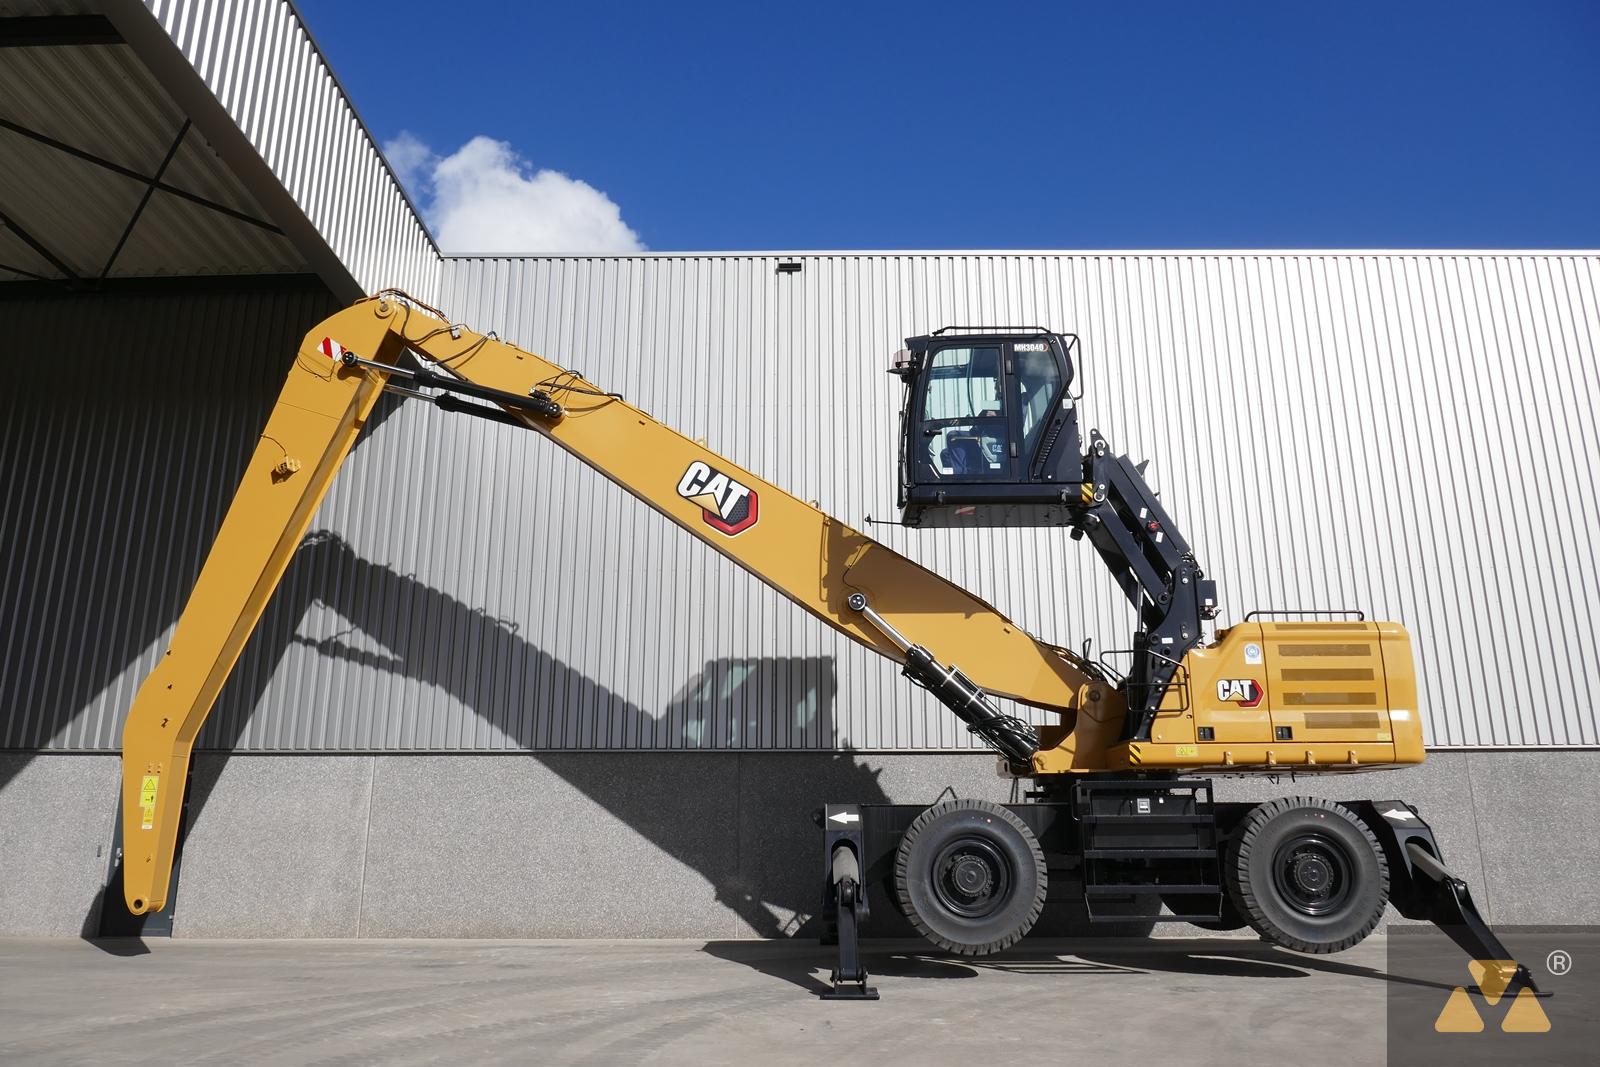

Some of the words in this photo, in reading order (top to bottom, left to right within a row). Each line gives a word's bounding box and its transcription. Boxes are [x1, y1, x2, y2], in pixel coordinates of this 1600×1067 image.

[1013, 343, 1044, 352] MH3040
[677, 461, 751, 520] CAT
[1217, 679, 1252, 701] CAT
